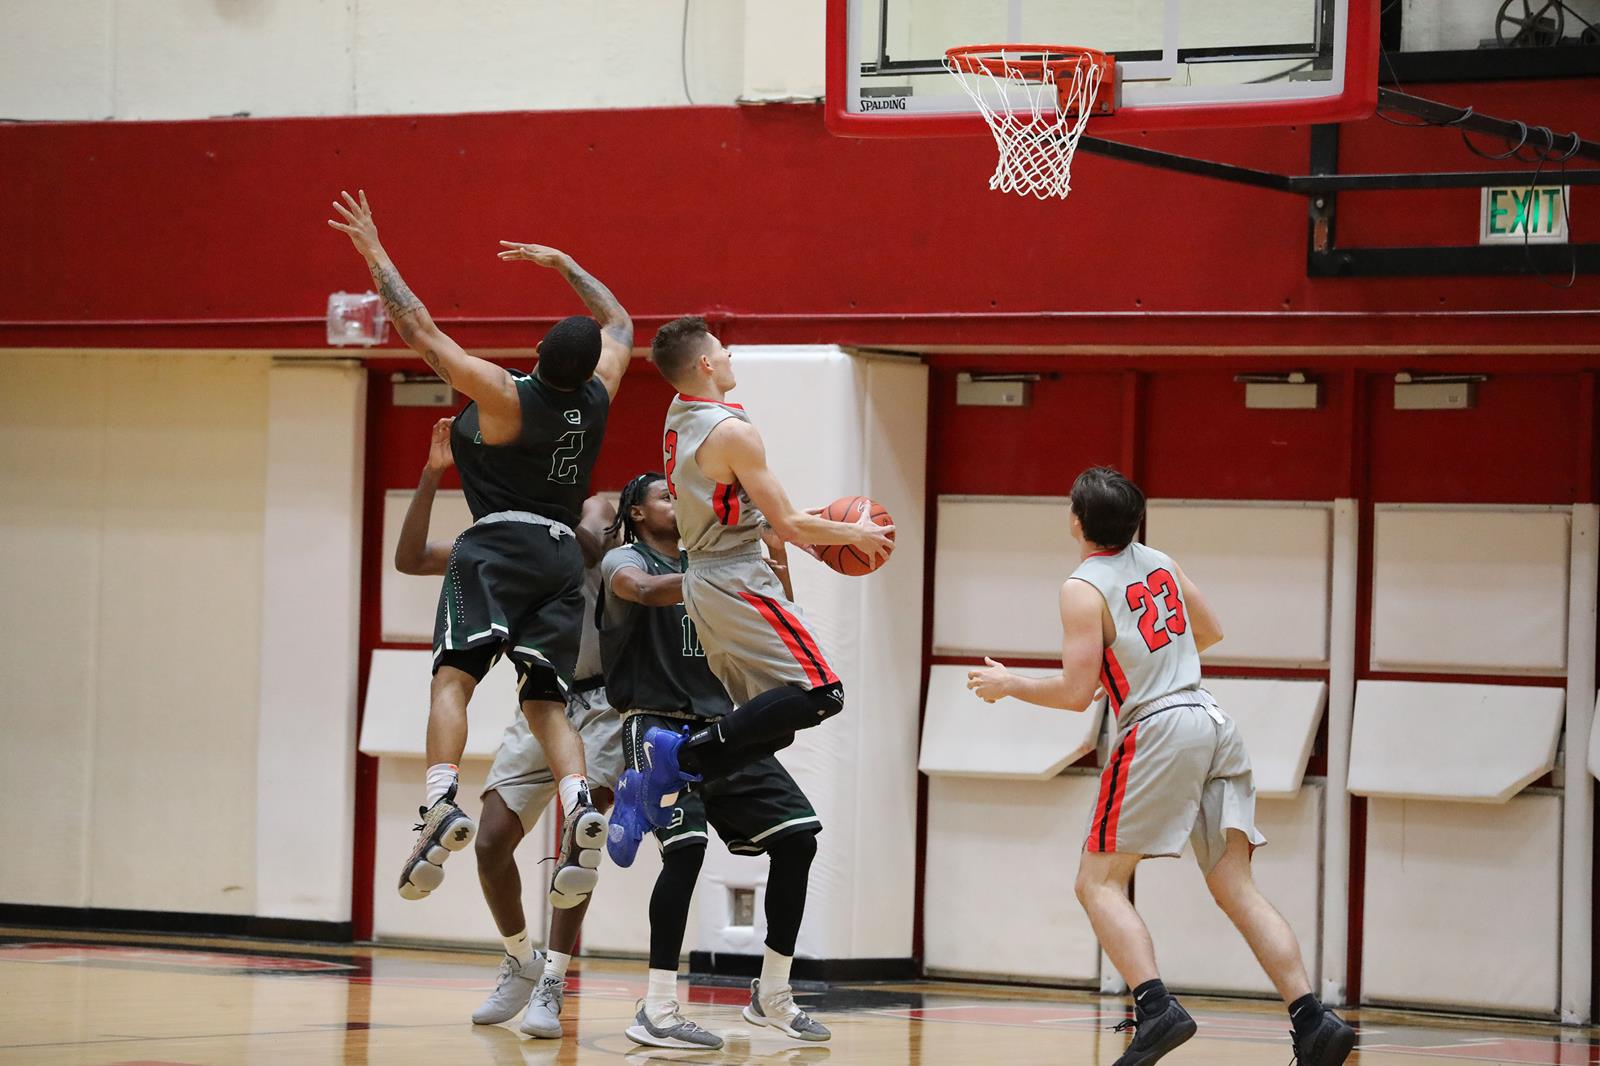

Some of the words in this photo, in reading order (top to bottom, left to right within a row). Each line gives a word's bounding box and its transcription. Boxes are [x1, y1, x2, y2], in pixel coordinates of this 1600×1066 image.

[860, 98, 906, 112] SPALDING
[1490, 189, 1560, 233] EXIT
[547, 430, 586, 484] 2
[665, 429, 678, 500] 2
[1125, 567, 1187, 653] 23
